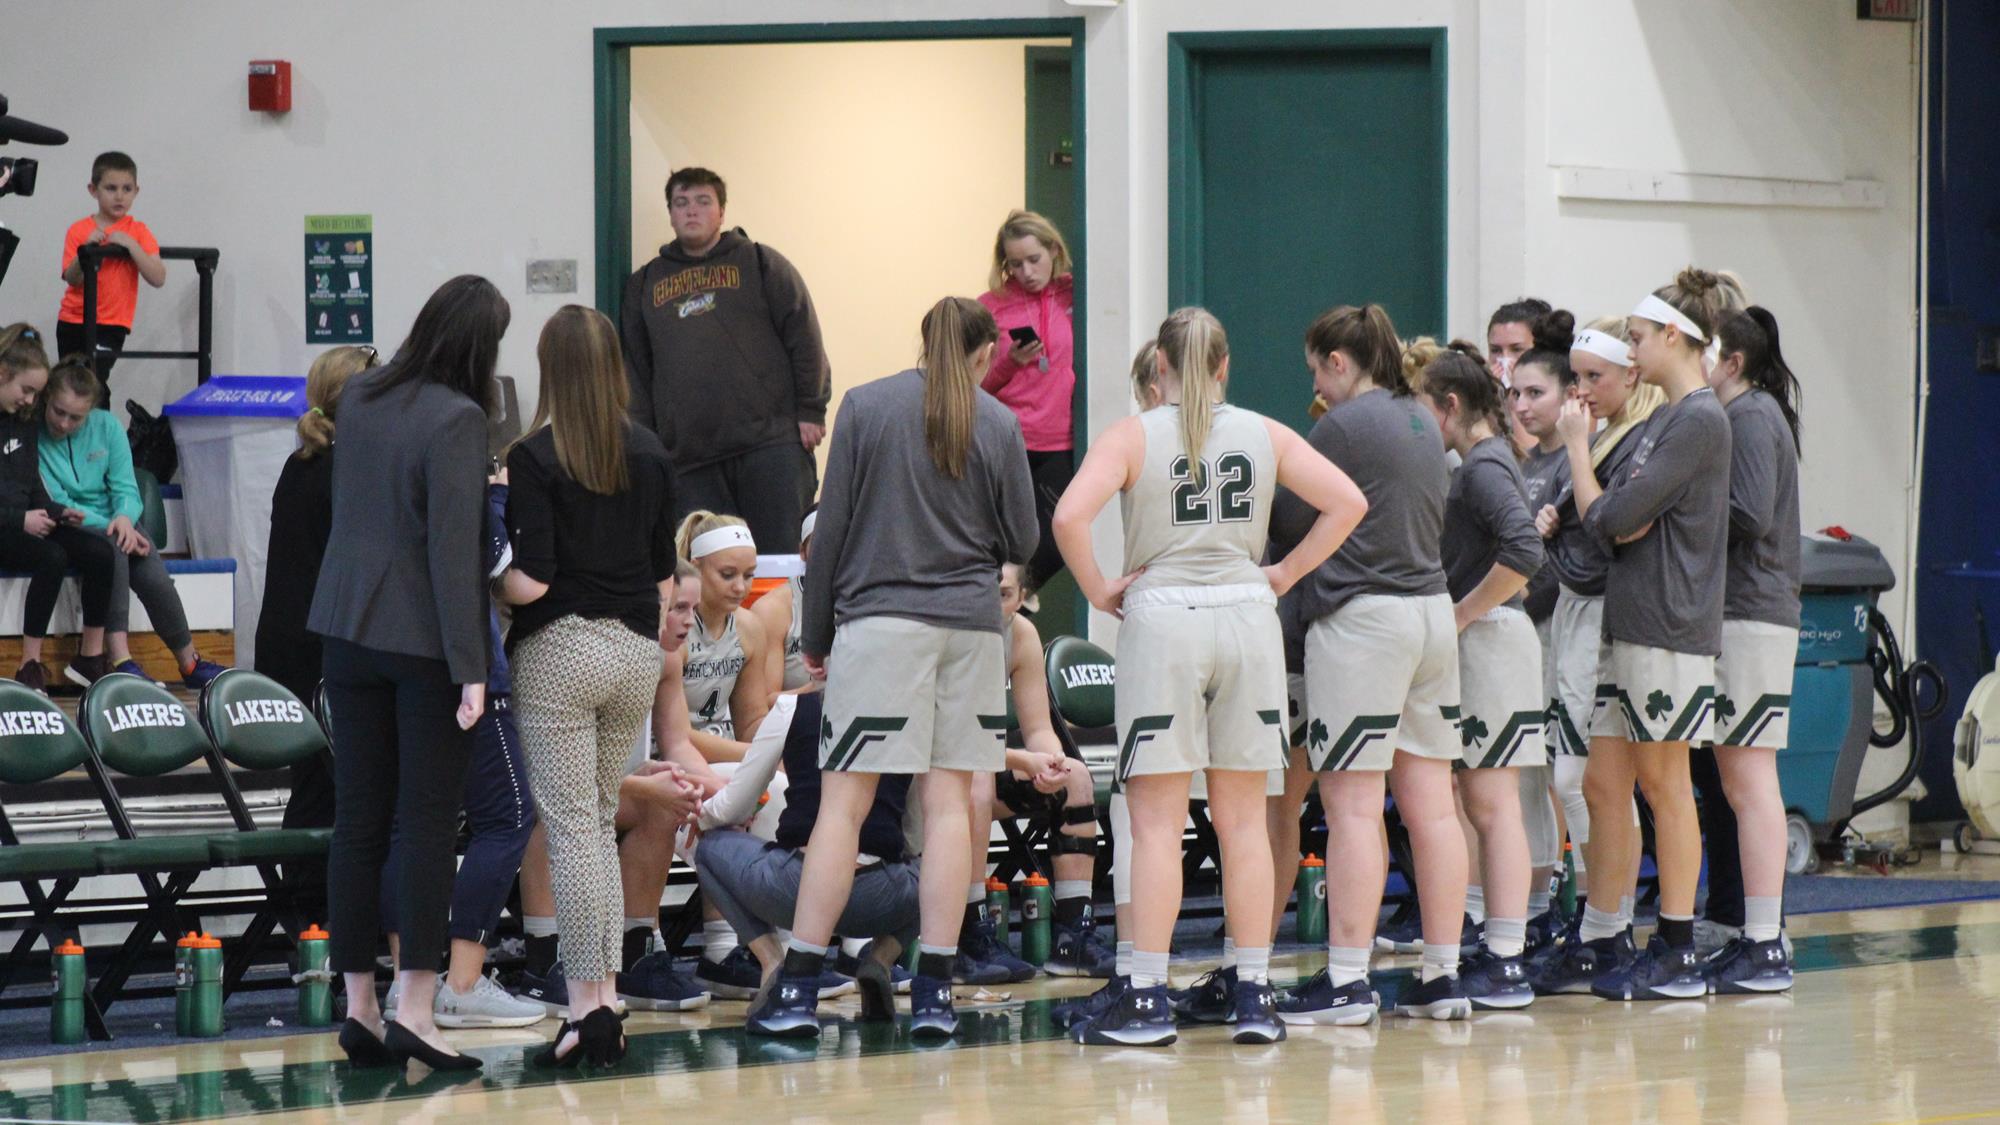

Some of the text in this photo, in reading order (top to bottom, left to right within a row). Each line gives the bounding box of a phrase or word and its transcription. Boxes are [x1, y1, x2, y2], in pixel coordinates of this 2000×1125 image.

[653, 265, 741, 308] CLEVELAND
[1169, 450, 1255, 526] 22
[103, 703, 186, 733] LAKERS
[224, 699, 304, 727] LAKERS
[696, 687, 721, 723] 4
[0, 711, 65, 737] AKERS
